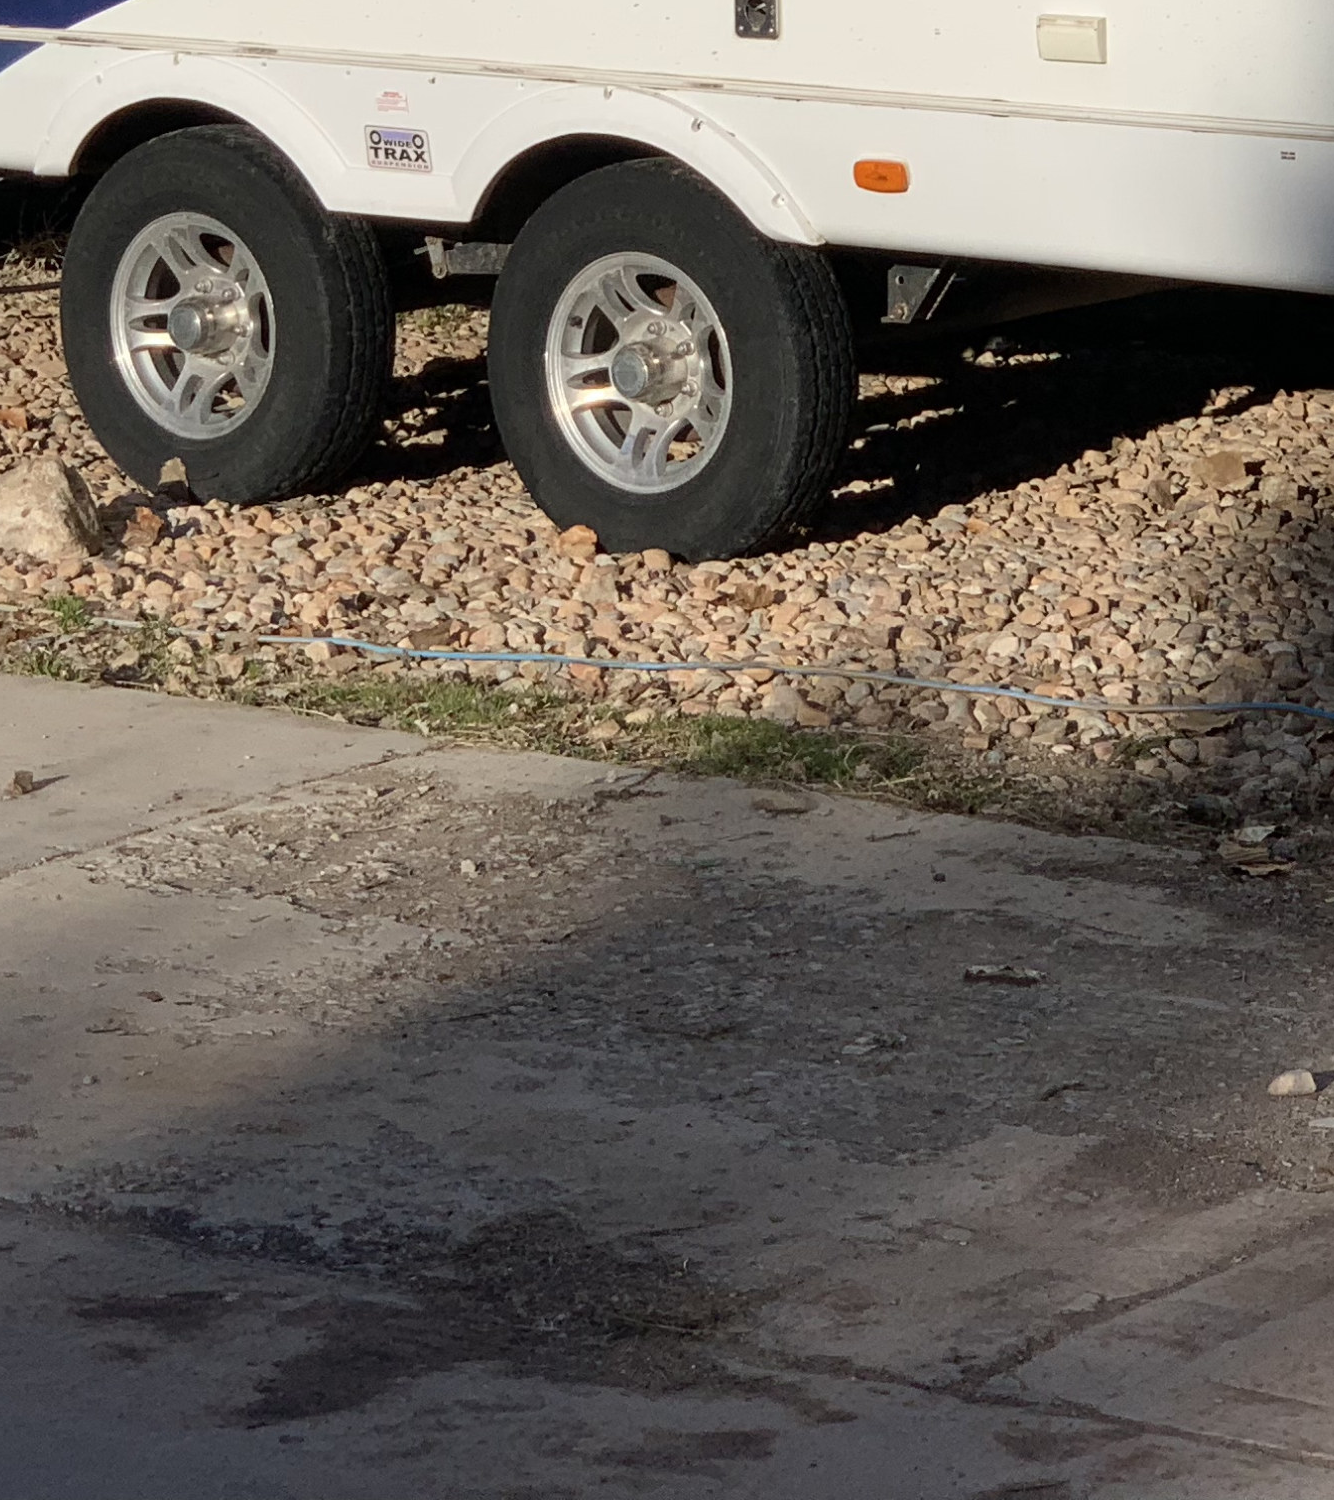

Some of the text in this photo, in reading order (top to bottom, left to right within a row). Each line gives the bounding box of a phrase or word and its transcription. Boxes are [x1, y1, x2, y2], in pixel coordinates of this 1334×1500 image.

[383, 139, 413, 148] WIDE
[369, 146, 427, 163] TRAX
[371, 160, 429, 169] SUSPENSION
